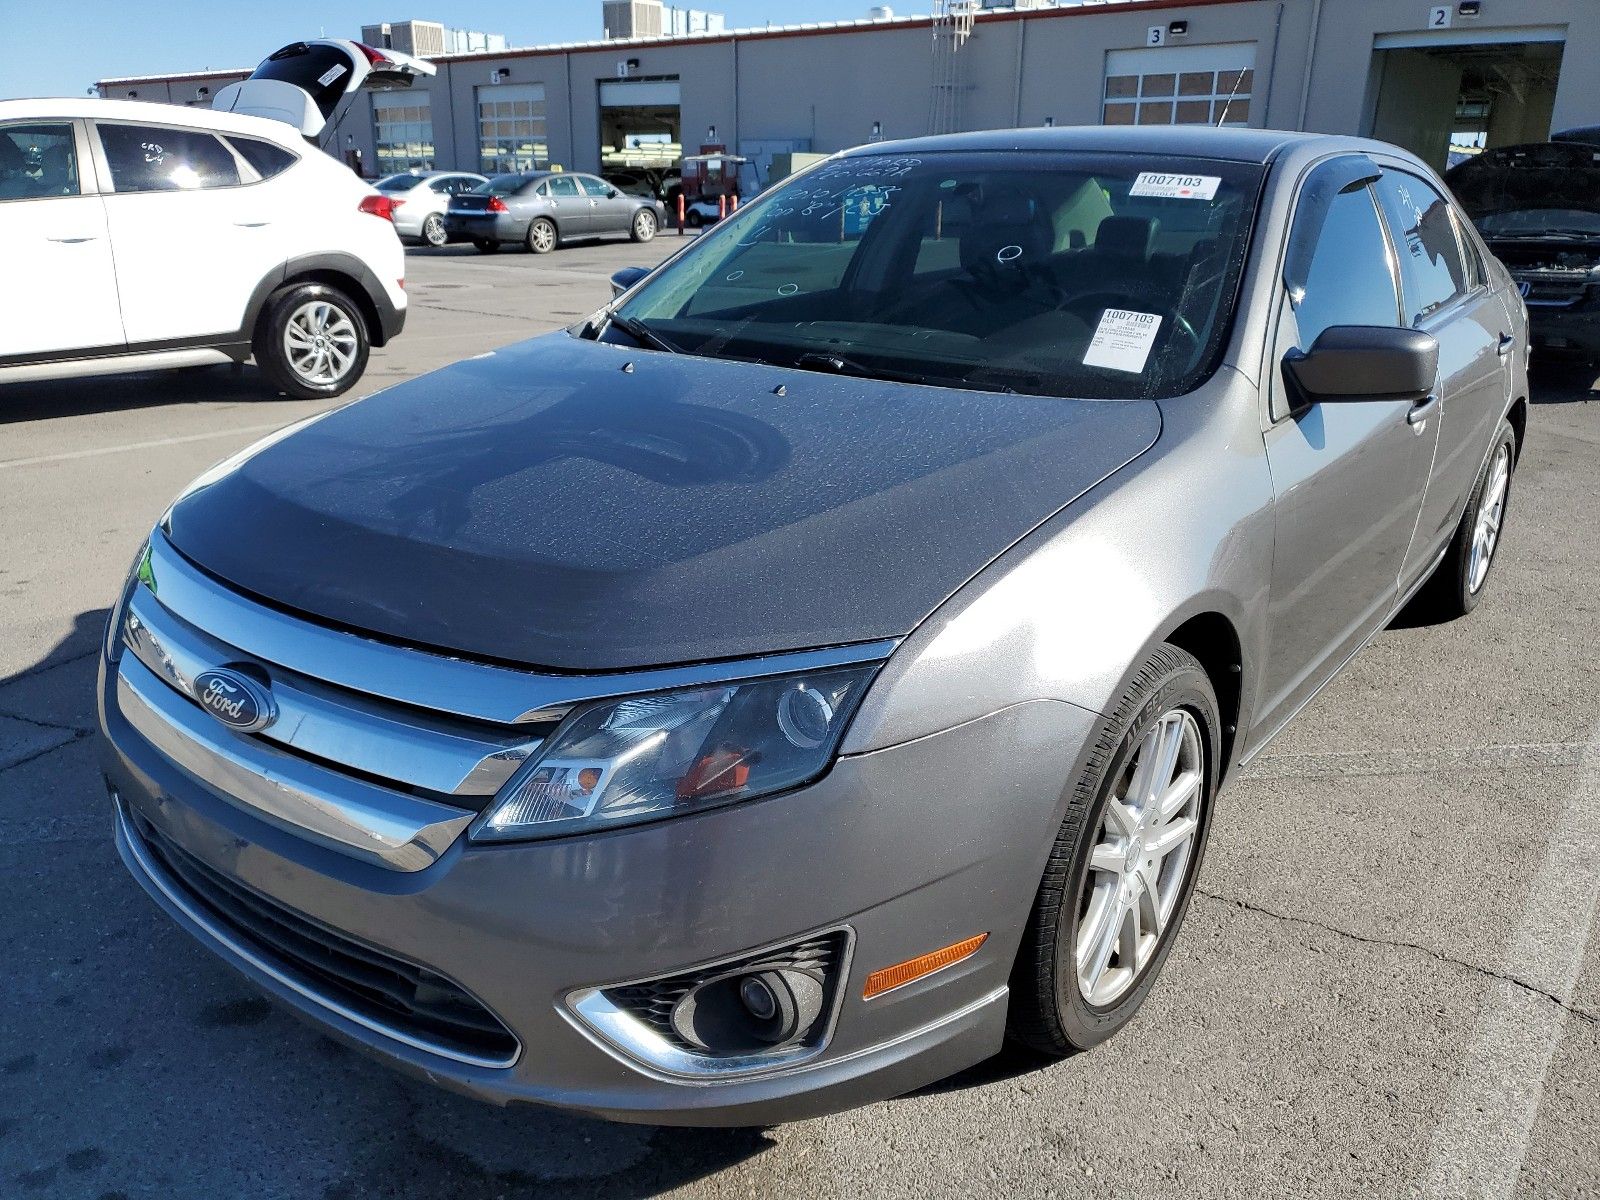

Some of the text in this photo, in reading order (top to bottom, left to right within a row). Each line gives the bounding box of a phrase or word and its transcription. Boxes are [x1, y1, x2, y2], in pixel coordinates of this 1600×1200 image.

[1435, 9, 1445, 25] 2
[1152, 29, 1160, 43] 3
[1140, 175, 1203, 187] 1007103
[1105, 310, 1155, 324] 1007103
[203, 678, 245, 719] Ford
